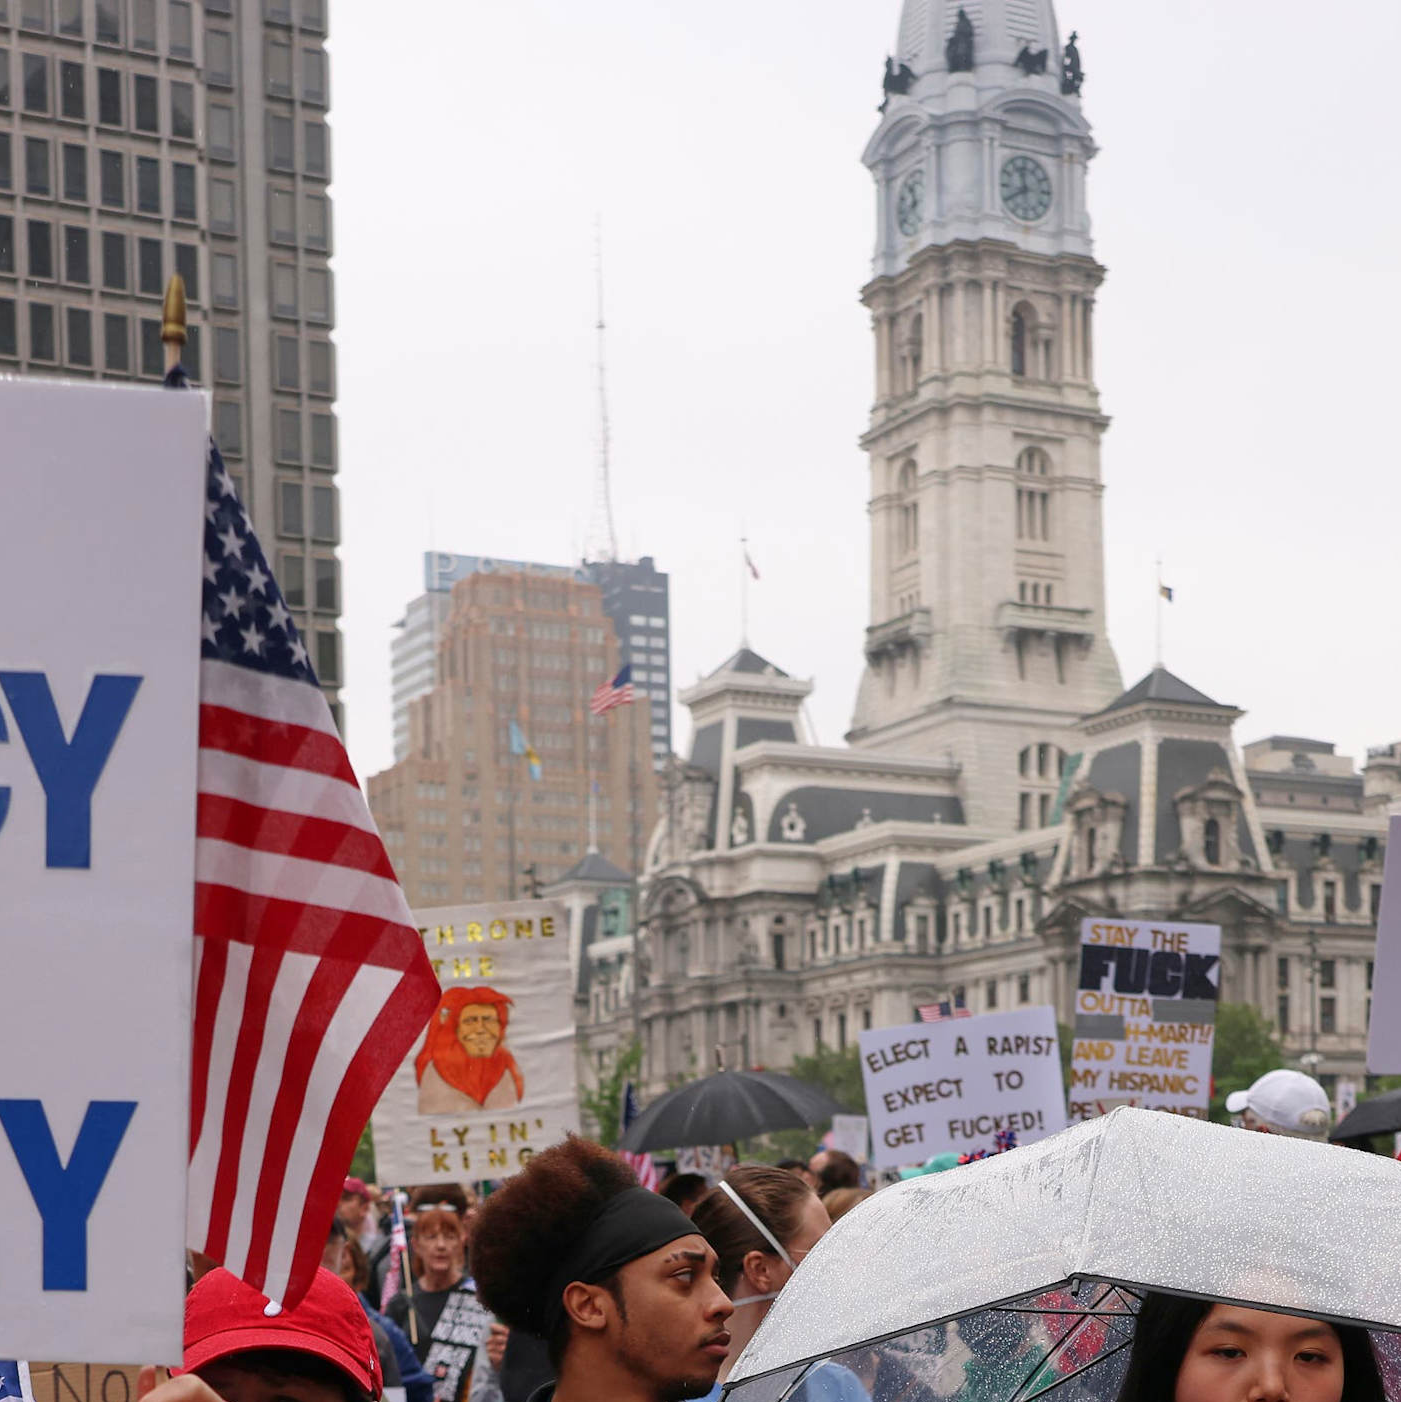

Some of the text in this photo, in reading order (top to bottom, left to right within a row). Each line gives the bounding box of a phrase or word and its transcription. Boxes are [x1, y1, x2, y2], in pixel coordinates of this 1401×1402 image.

[1089, 924, 1189, 953] STAY THE
[1079, 944, 1220, 1000] FUCK
[1080, 991, 1152, 1017] OUTTA
[866, 1035, 1057, 1073] ELECT A RAPIST
[1073, 1041, 1190, 1069] AND LEAVE
[882, 1070, 1025, 1114] EXPECT TO
[1071, 1067, 1199, 1096] MY HISPANIC
[884, 1122, 927, 1149] GET
[948, 1110, 1045, 1141] FUCKED!
